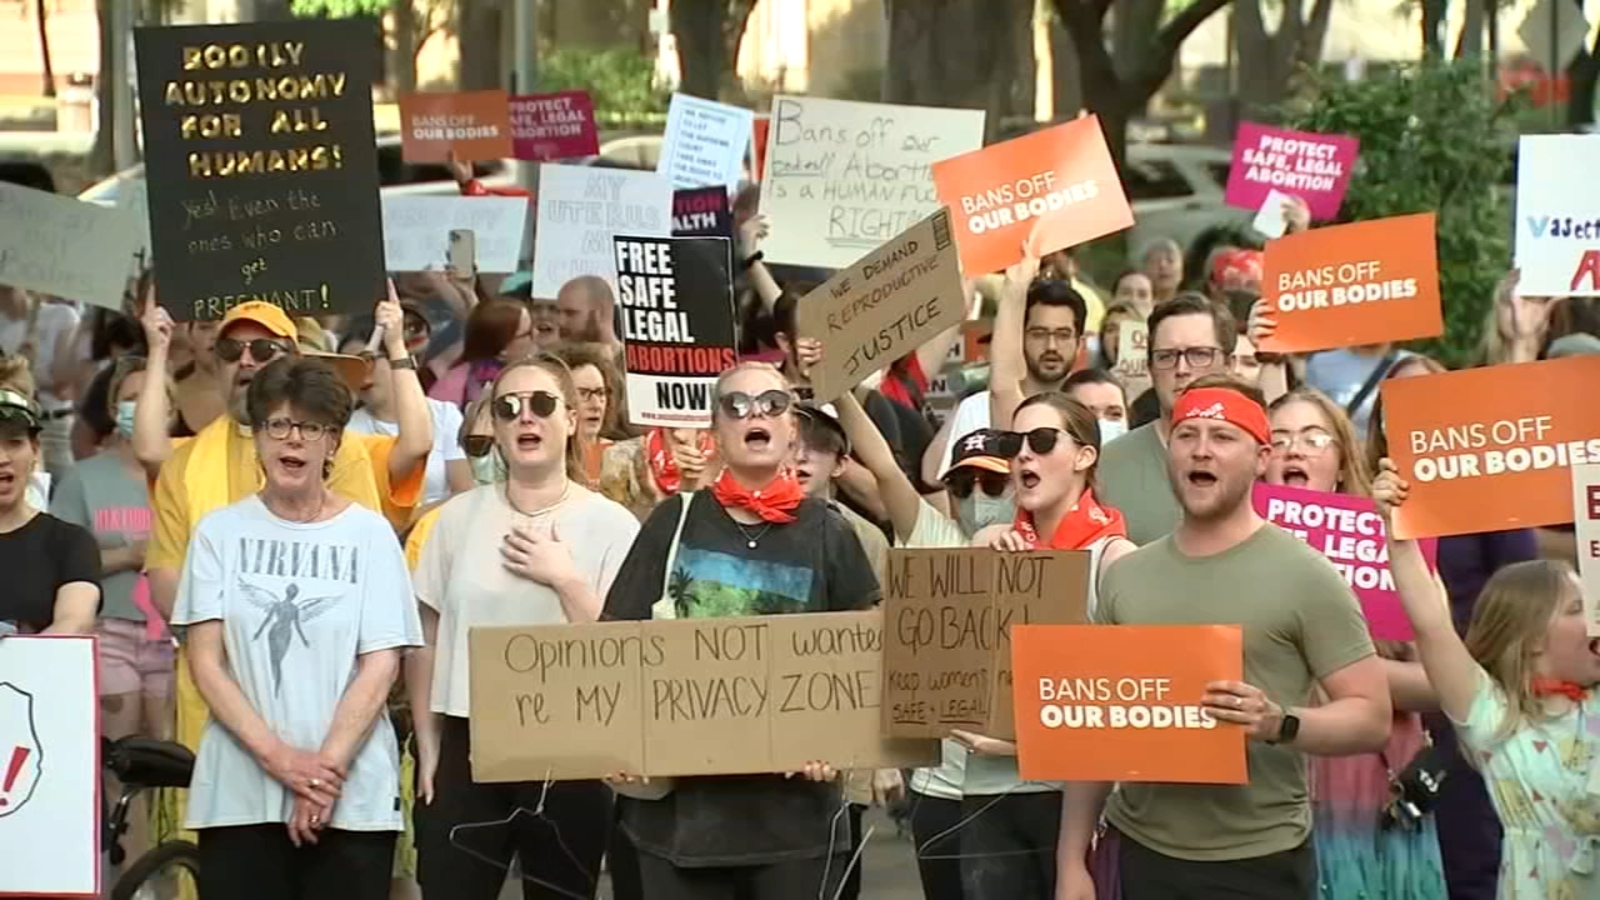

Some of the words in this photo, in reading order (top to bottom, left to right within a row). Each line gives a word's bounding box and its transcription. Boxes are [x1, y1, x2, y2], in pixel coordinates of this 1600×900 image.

[183, 41, 304, 70] BODILY
[164, 72, 346, 106] AUTONOMY
[181, 113, 242, 139] FOR
[271, 107, 328, 134] ALL
[413, 127, 444, 140] OUR
[446, 125, 499, 140] BODIES
[540, 109, 587, 123] LEGAL
[775, 99, 847, 146] Bans
[856, 116, 894, 148] off
[188, 144, 343, 177] HUMANS!
[1242, 149, 1291, 172] SAFE,
[1295, 156, 1344, 176] LEGAL
[1259, 135, 1338, 160] PROTECT
[799, 183, 815, 200] a
[823, 179, 893, 201] HUMAN
[900, 184, 937, 203] FUC
[961, 183, 1015, 215] BANS
[1016, 171, 1057, 197] OFF
[1245, 166, 1335, 191] ABORTION
[229, 195, 279, 221] Even
[288, 189, 322, 211] the
[548, 200, 661, 231] UTERUS
[968, 207, 1014, 234] OUR
[1014, 179, 1100, 221] BODIES
[188, 235, 232, 254] ones
[243, 227, 282, 249] who
[294, 219, 337, 241] can
[241, 257, 267, 285] get
[615, 241, 673, 275] FREE
[830, 278, 852, 300] WE
[862, 241, 919, 281] DEMAND
[619, 275, 678, 309] SAFE
[1279, 266, 1335, 291] BANS
[1338, 261, 1381, 283] OFF
[194, 284, 329, 318] PREANT!
[827, 254, 941, 334] REPRODUCTIVE
[1278, 289, 1329, 312] OUR
[1333, 278, 1417, 306] BODIES
[624, 308, 695, 343] LEGAL
[843, 297, 941, 376] JUSTICE
[626, 344, 736, 374] ABORTIONS
[1411, 424, 1486, 454] BANS
[1492, 416, 1553, 444] OFF
[1414, 453, 1481, 482] OUR
[1485, 438, 1600, 475] BODIES
[237, 537, 358, 584] NIRVANA
[1324, 534, 1389, 564] LEGA
[889, 555, 916, 599] WE
[930, 555, 987, 599] WILL
[998, 555, 1054, 599] NOT
[898, 606, 934, 656] GO
[504, 632, 665, 684] Opinions
[695, 623, 768, 662] NOT
[516, 692, 549, 728] re
[575, 682, 622, 727] MY
[653, 675, 768, 723] PRIVACY
[779, 669, 881, 713] ZONE
[1039, 678, 1110, 701] BANS
[1116, 678, 1170, 701] OFF
[892, 701, 927, 720] SAFE
[1040, 704, 1105, 729] OUR
[1110, 704, 1218, 730] BODIES
